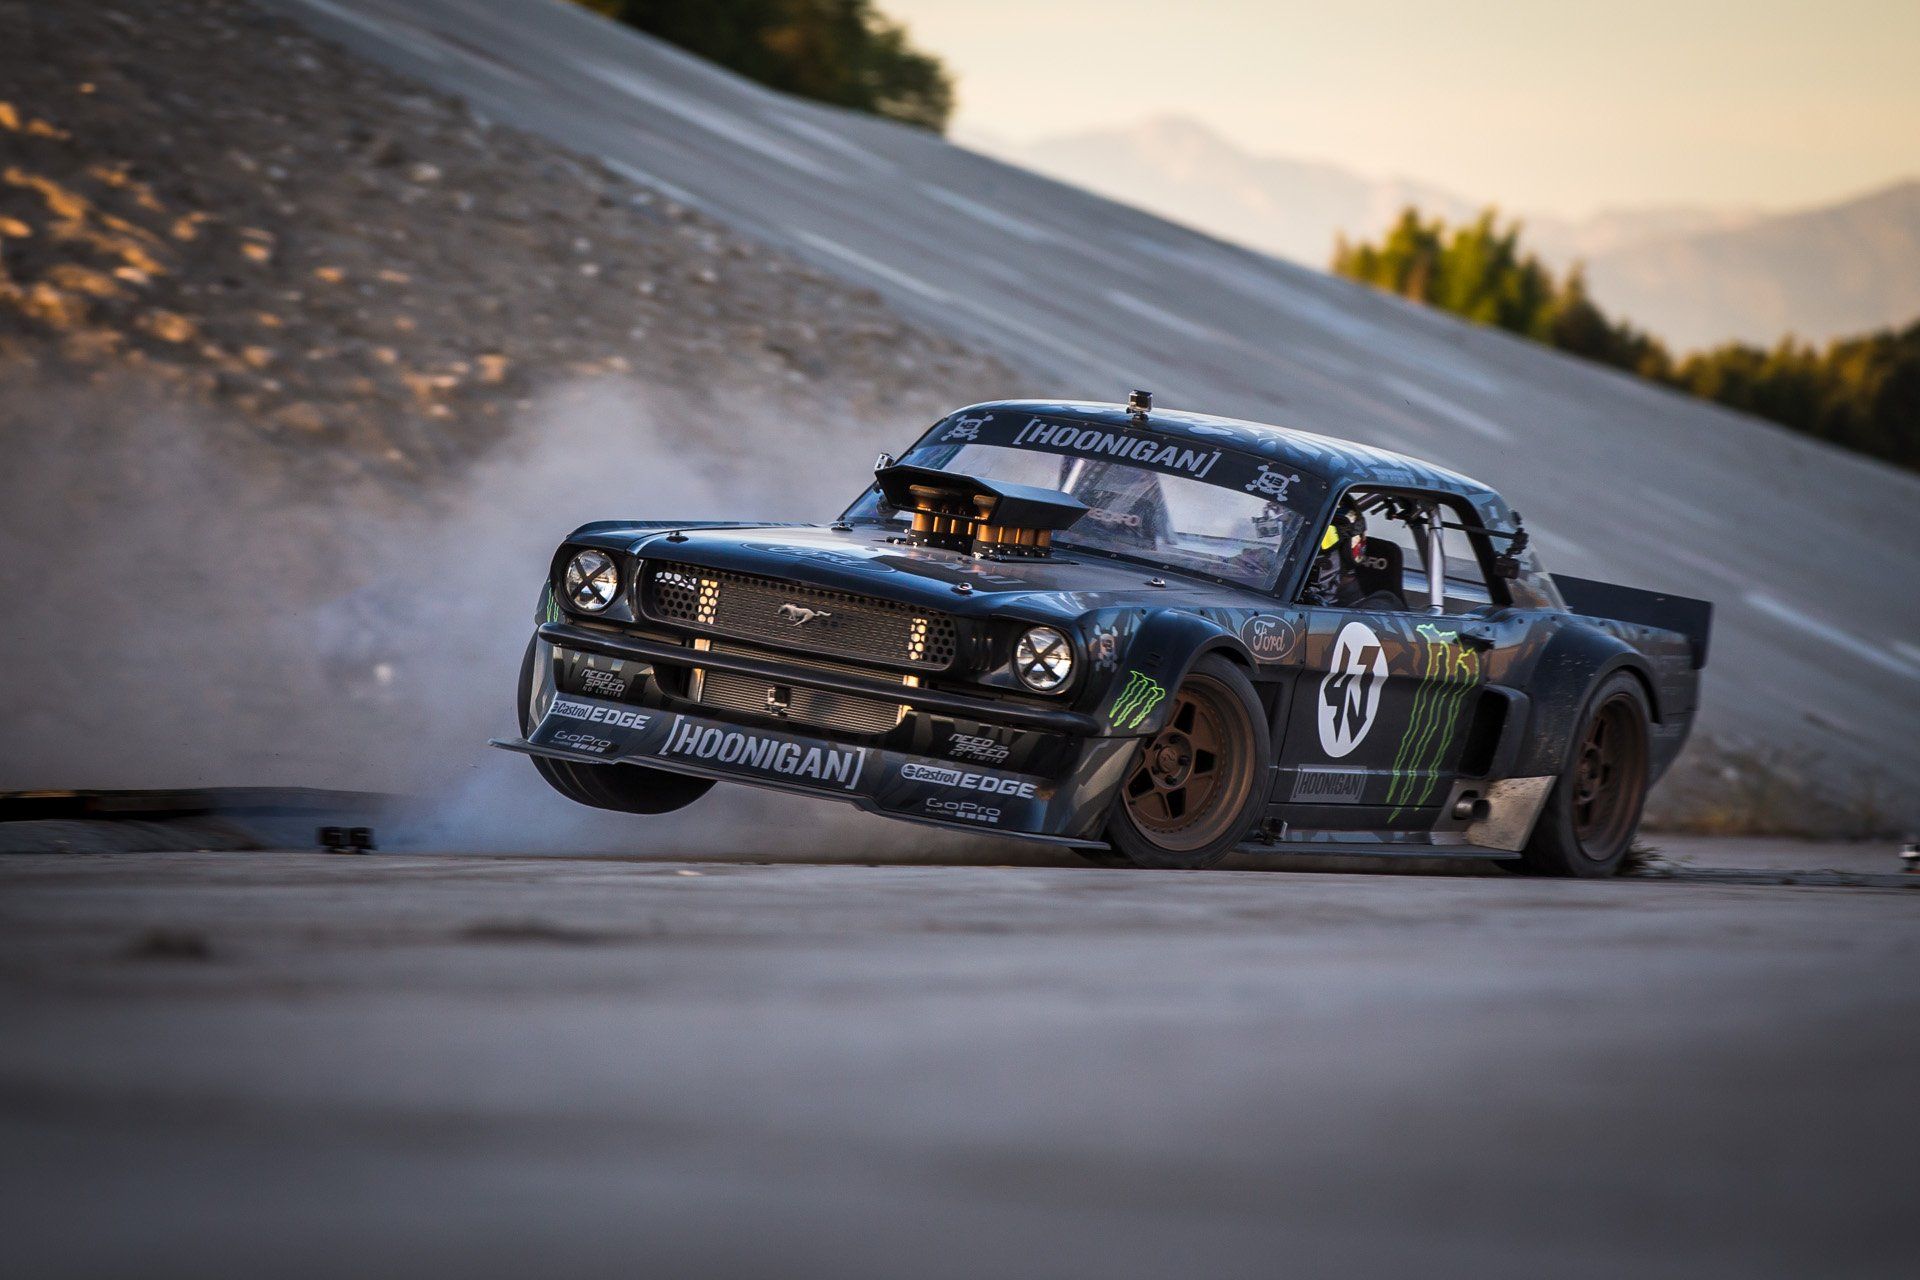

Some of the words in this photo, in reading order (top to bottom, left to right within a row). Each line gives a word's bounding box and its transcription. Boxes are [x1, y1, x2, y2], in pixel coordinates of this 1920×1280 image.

[1253, 620, 1285, 652] Ford
[581, 669, 614, 681] NEED
[585, 678, 625, 692] SPEED
[558, 702, 590, 718] Castrol
[589, 707, 651, 730] EDGE
[554, 730, 612, 748] GoPro
[949, 733, 994, 747] NEED
[953, 744, 1010, 759] SPEED
[914, 767, 957, 784] Castrol
[960, 773, 1037, 799] EDGE
[926, 797, 1001, 816] GoPro
